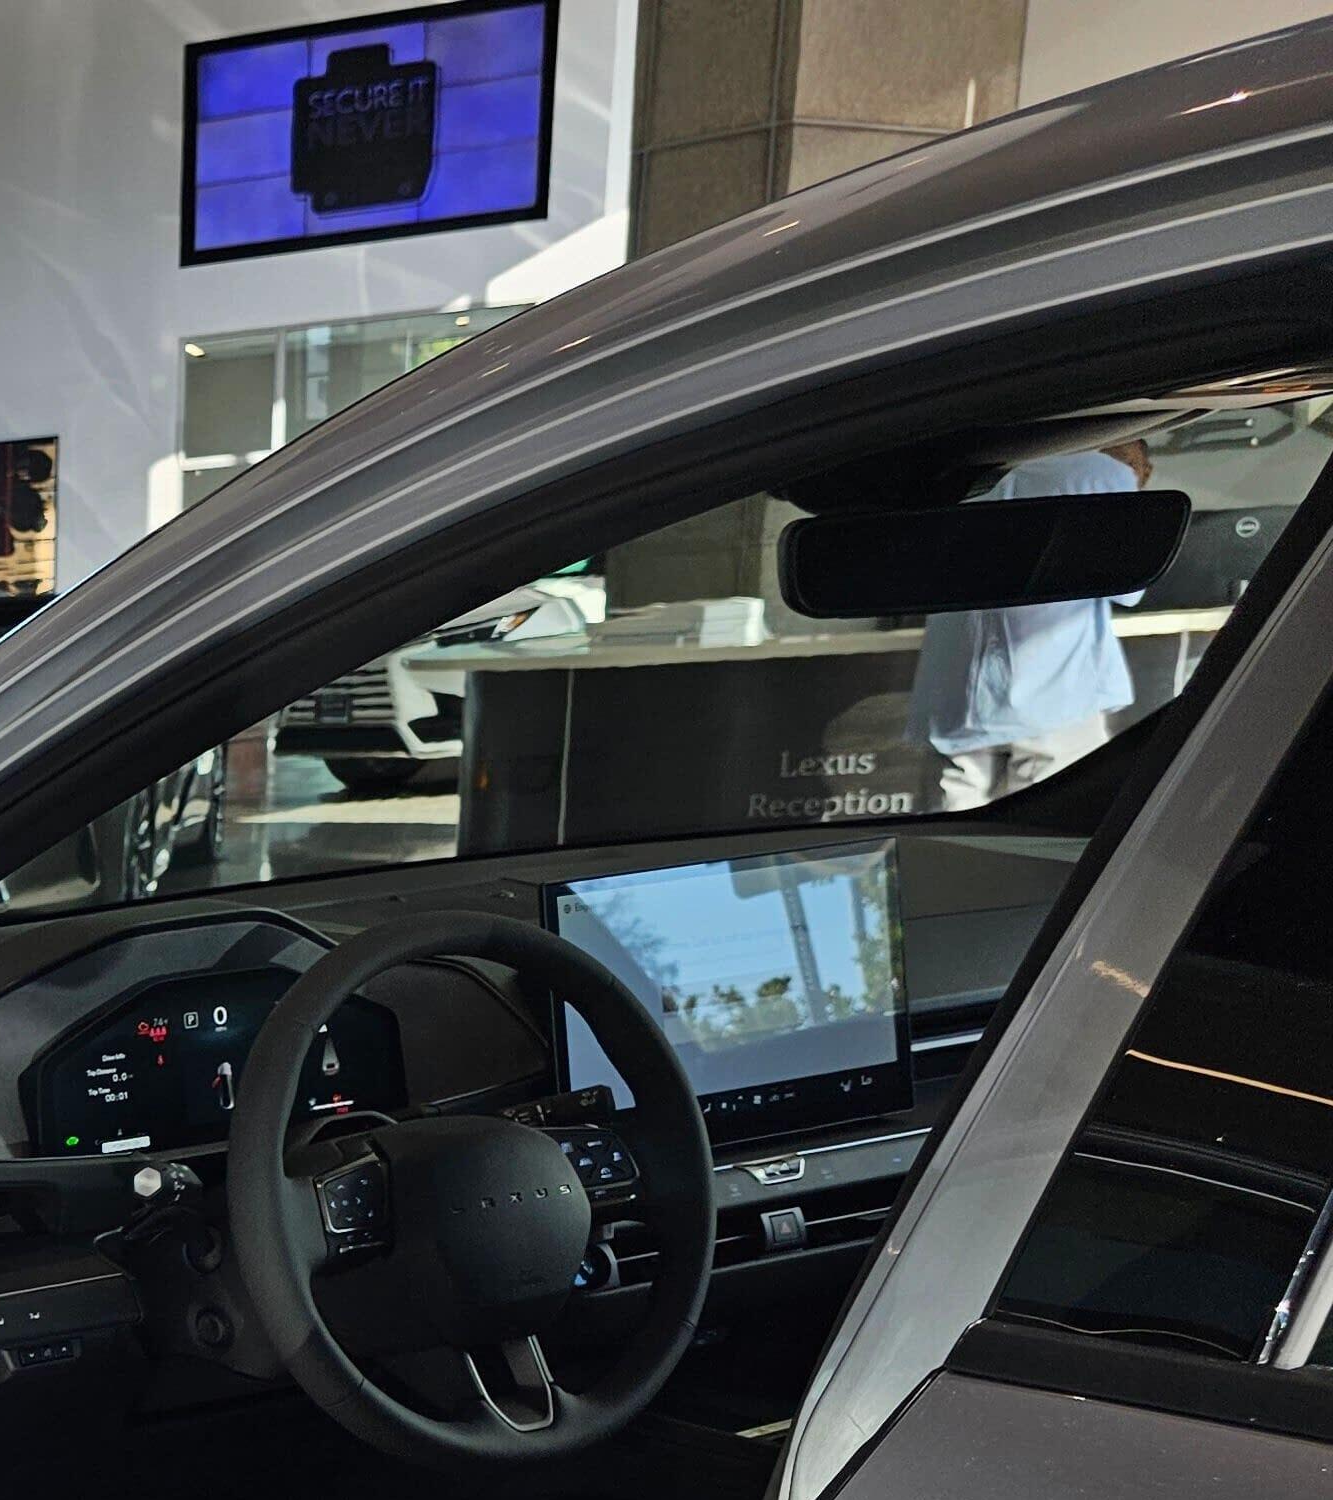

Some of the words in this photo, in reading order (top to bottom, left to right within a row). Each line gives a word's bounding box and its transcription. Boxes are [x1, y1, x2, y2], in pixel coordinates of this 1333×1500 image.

[780, 751, 878, 778] Lexus
[747, 788, 914, 822] Reception
[213, 1006, 227, 1025] 0
[112, 1072, 127, 1082] 0.0
